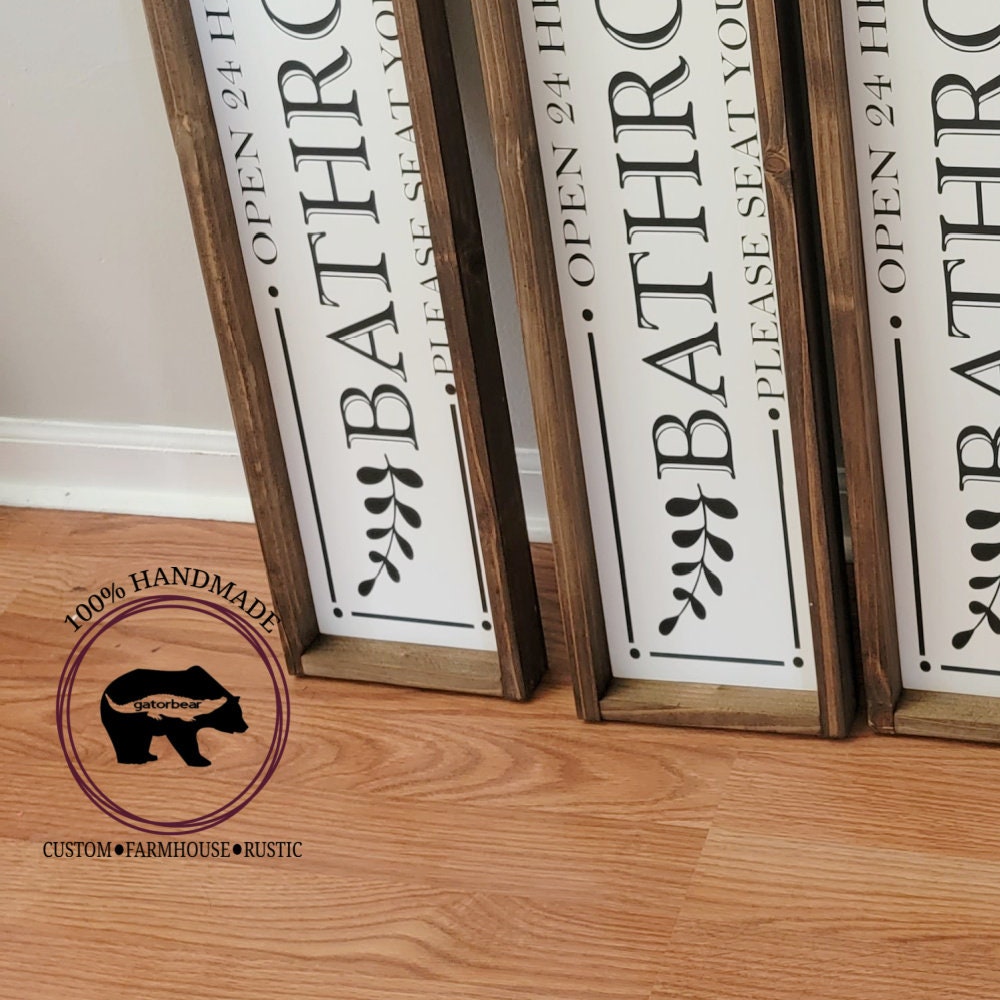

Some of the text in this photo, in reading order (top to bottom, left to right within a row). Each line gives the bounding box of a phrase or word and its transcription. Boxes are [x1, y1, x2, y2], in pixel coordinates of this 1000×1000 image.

[217, 61, 248, 109] 24
[542, 73, 575, 124] 24
[863, 75, 894, 126] 24
[233, 127, 277, 265] OPEN
[555, 142, 595, 287] OPEN
[726, 99, 766, 218] SEAT
[872, 144, 906, 293] OPEN
[741, 233, 786, 401] PLEASE
